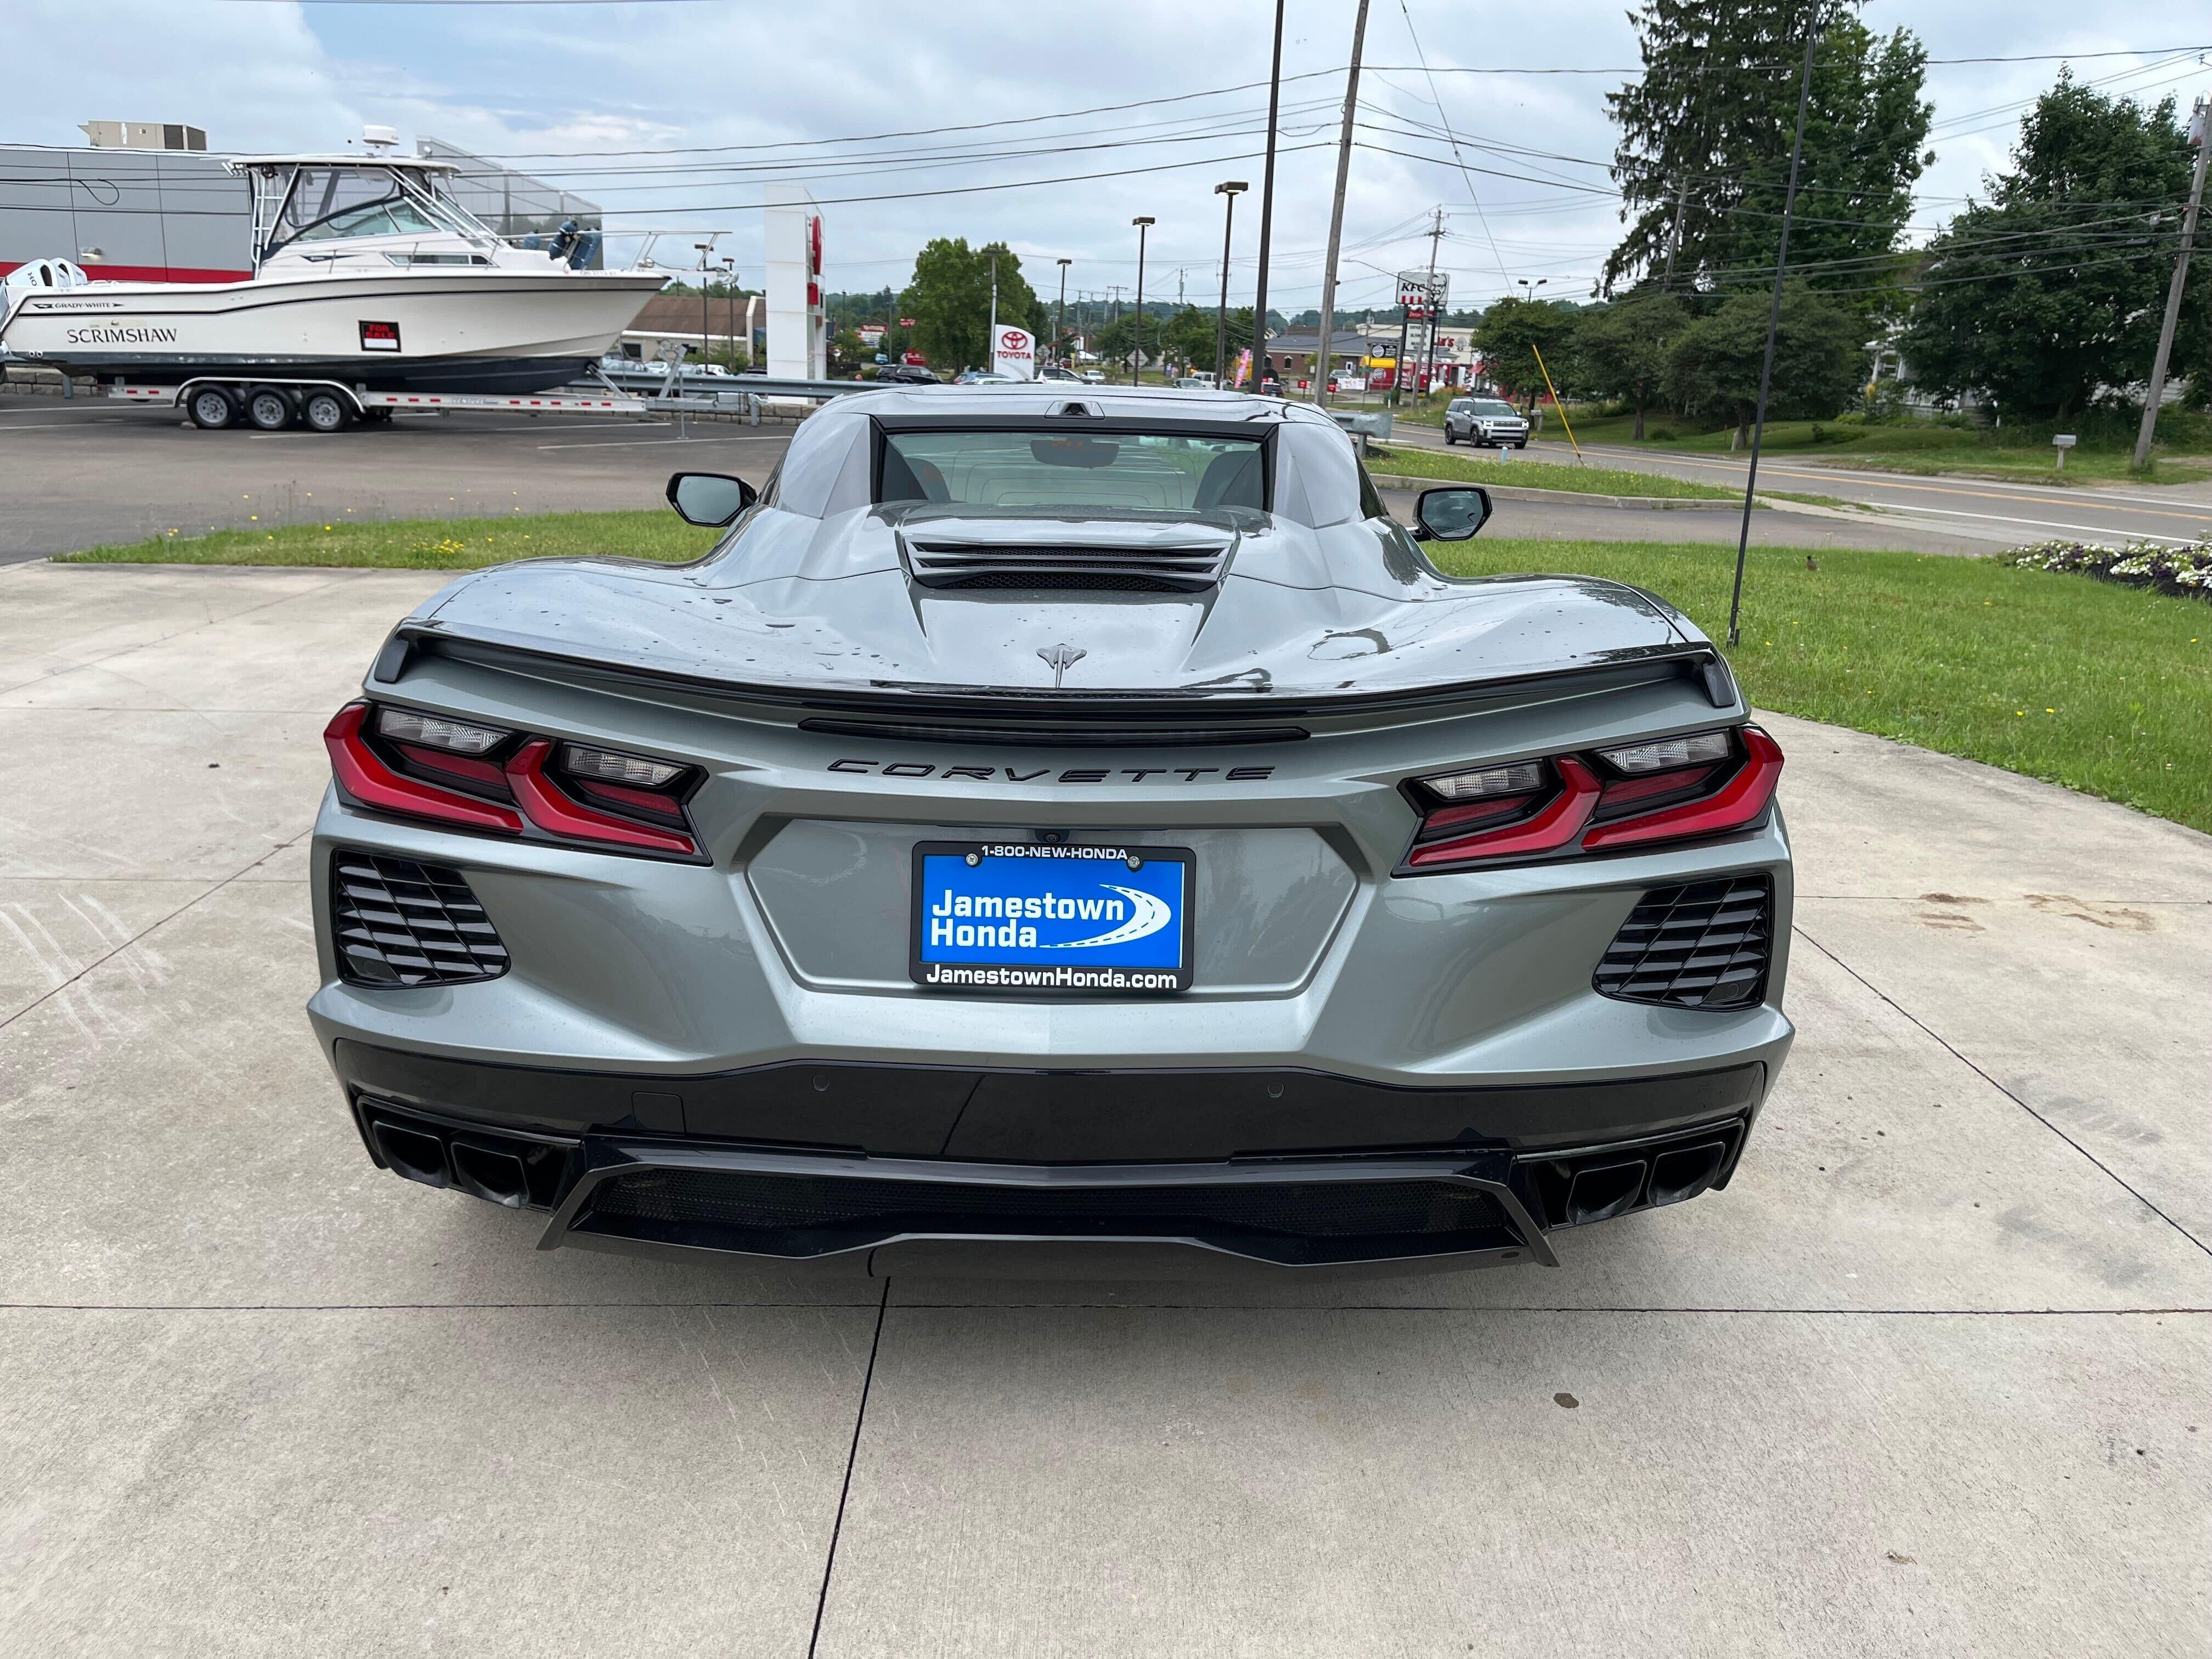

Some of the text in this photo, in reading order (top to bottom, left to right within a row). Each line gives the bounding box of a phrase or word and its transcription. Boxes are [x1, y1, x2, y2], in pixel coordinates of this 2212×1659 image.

[1401, 282, 1425, 292] KFC
[66, 328, 177, 344] SCRIMSHAW
[996, 351, 1032, 360] TOYOTA
[827, 758, 1276, 782] CORVETTE
[981, 845, 1127, 860] 1-800-NEW-HONDA
[932, 889, 1124, 921] Jamestown
[931, 918, 1037, 948] Honda
[926, 963, 1177, 989] JamestownHonda.com
